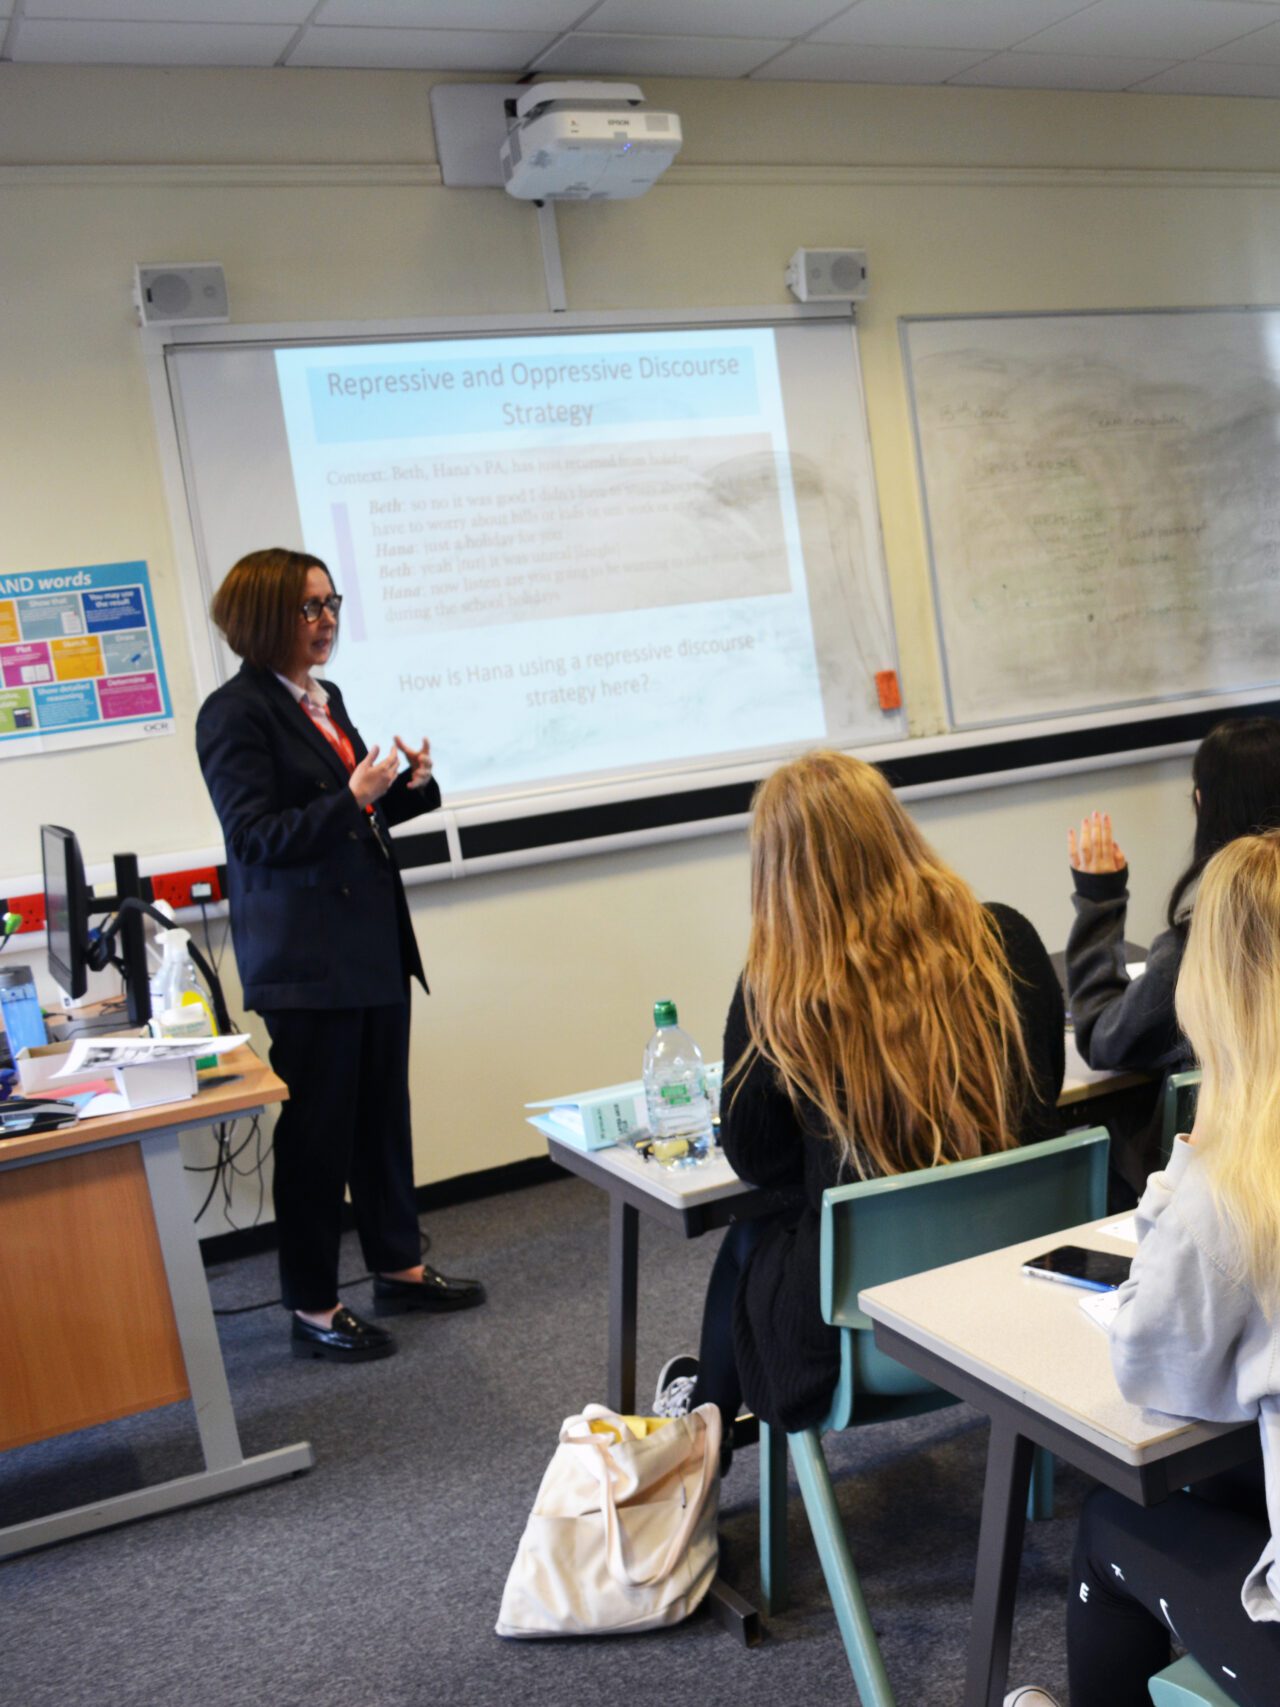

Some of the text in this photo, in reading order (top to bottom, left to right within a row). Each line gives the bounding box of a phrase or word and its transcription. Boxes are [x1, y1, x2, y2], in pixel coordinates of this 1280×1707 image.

[327, 355, 739, 400] Repressive and Oppressive Discourse
[502, 401, 594, 428] Strategy
[327, 469, 388, 486] Context:
[391, 463, 429, 482] Beth,
[432, 461, 481, 478] Hana's
[411, 499, 427, 511] so
[431, 497, 449, 510] no
[452, 494, 463, 508] it
[466, 494, 493, 506] was
[496, 487, 527, 506] good
[371, 520, 405, 537] have
[409, 520, 424, 533] to
[426, 517, 466, 531] worry
[471, 511, 508, 528] about
[375, 542, 419, 558] Hana:
[424, 538, 450, 555] just
[464, 532, 513, 551] holiday
[37, 570, 92, 591] words
[430, 582, 459, 596] now
[463, 576, 501, 593] listen
[384, 605, 433, 625] during
[434, 600, 457, 618] the
[398, 633, 755, 692] How is Hana using a repressive discourse
[525, 672, 649, 708] strategy here?
